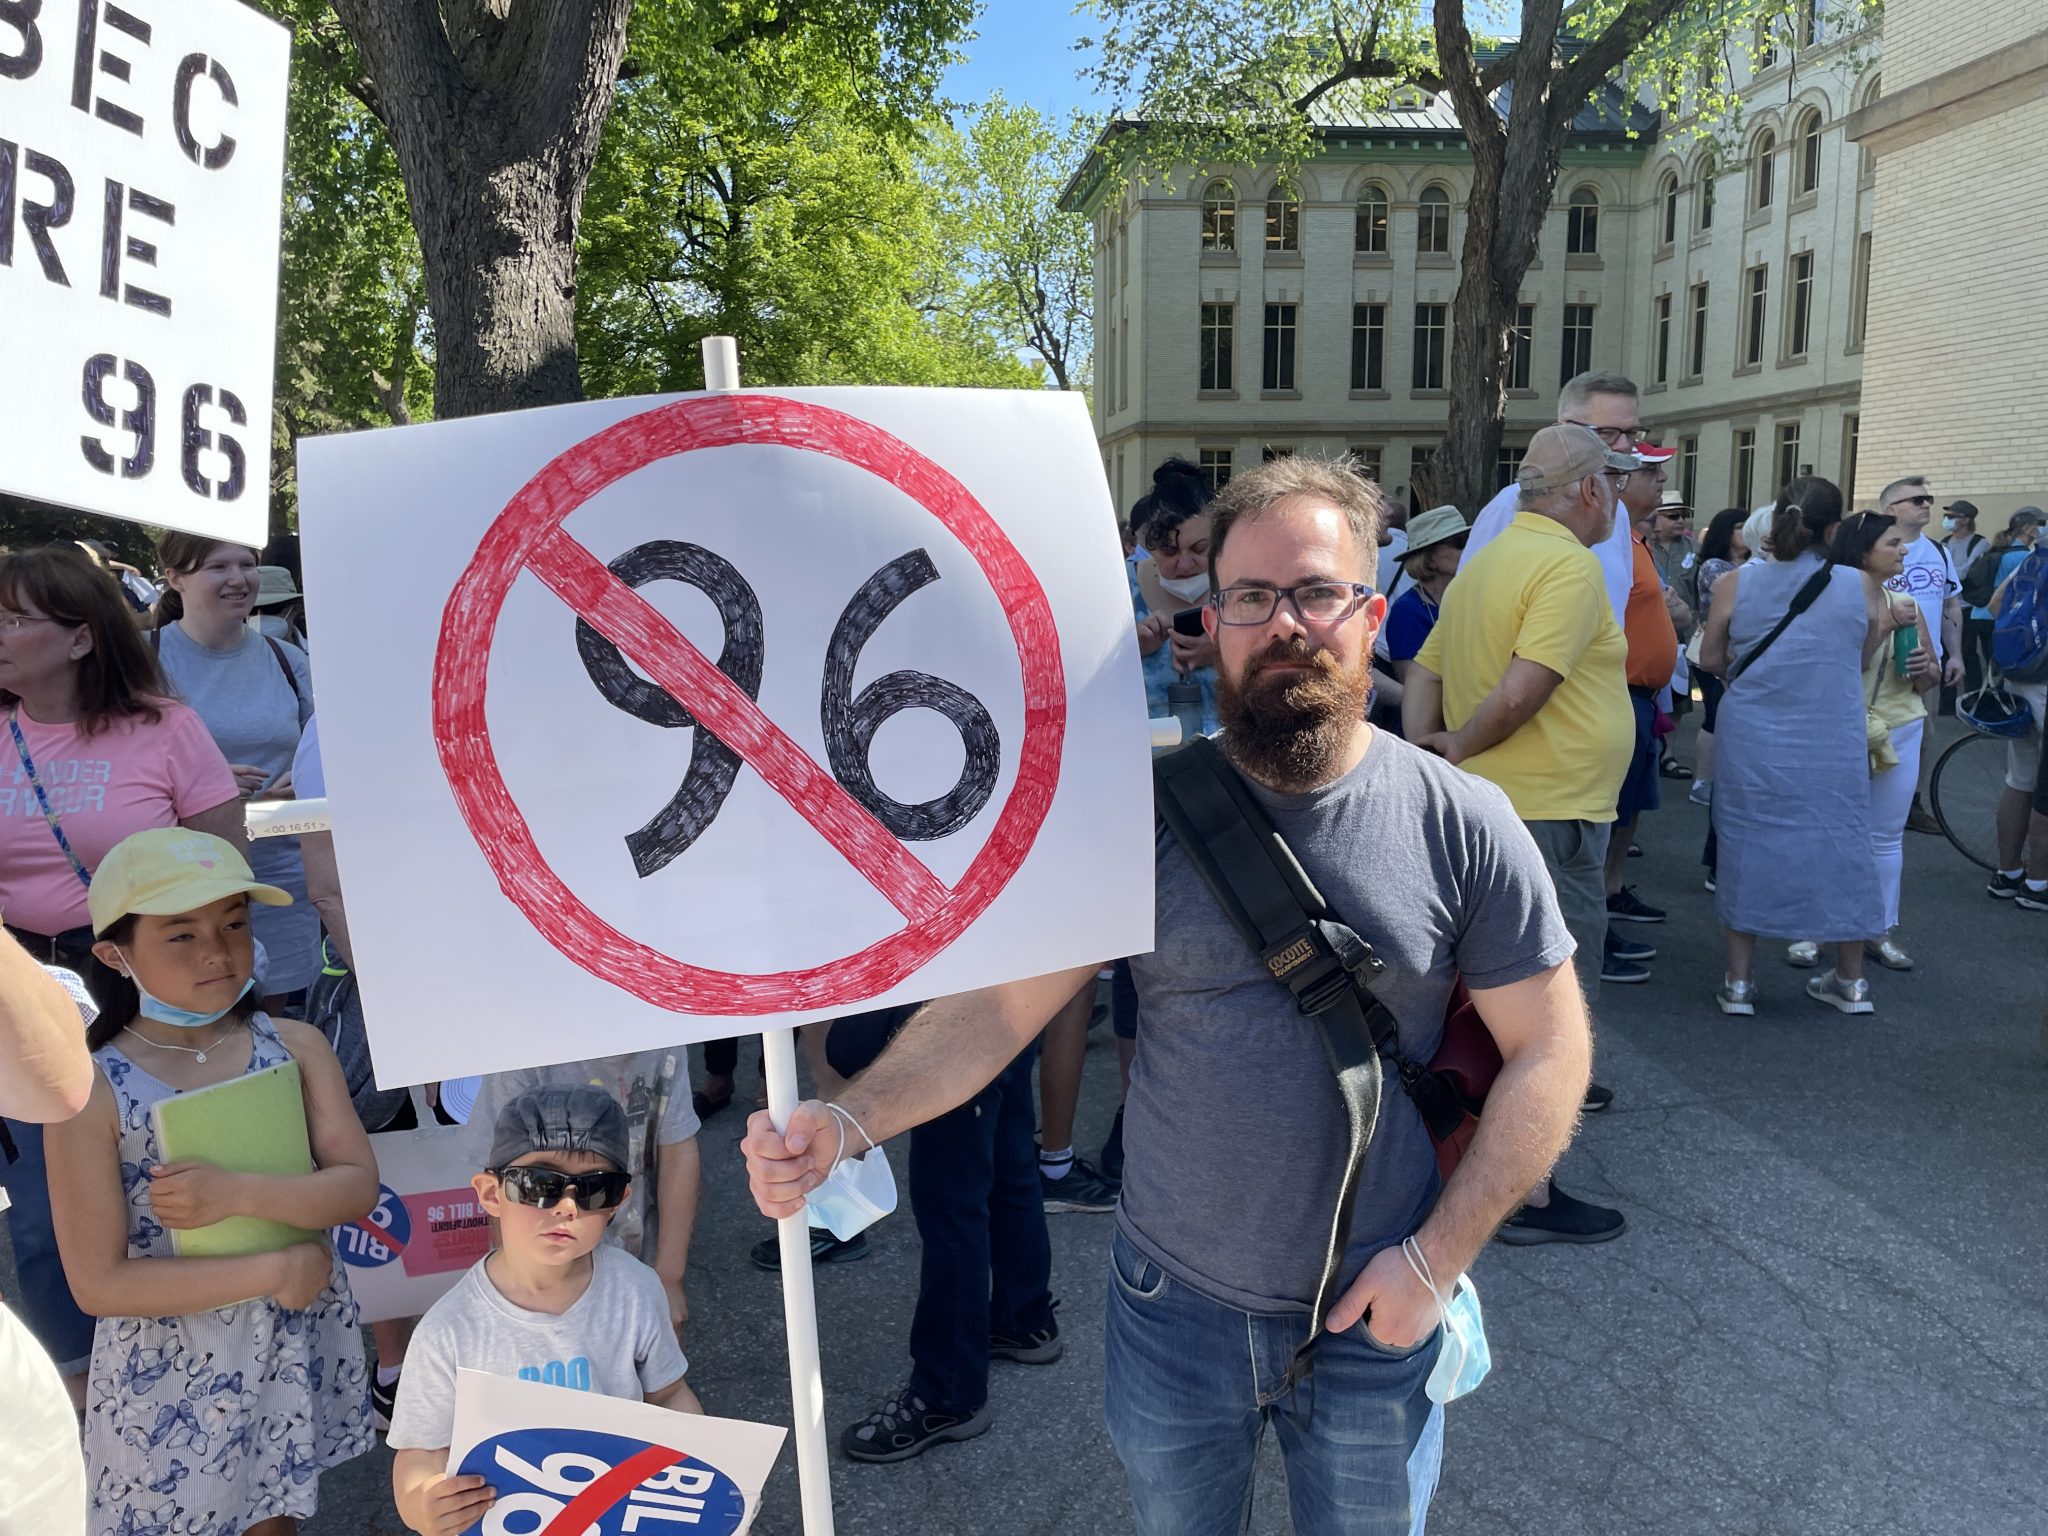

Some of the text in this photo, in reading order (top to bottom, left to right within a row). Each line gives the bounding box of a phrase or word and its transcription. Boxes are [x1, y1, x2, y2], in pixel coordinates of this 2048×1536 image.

[81, 352, 247, 502] 96
[575, 540, 1000, 878] 96
[29, 759, 112, 785] NDER
[1268, 938, 1312, 970] COCOTTE
[427, 1205, 445, 1222] 96
[448, 1202, 474, 1219] BILL
[621, 1464, 715, 1536] BIL
